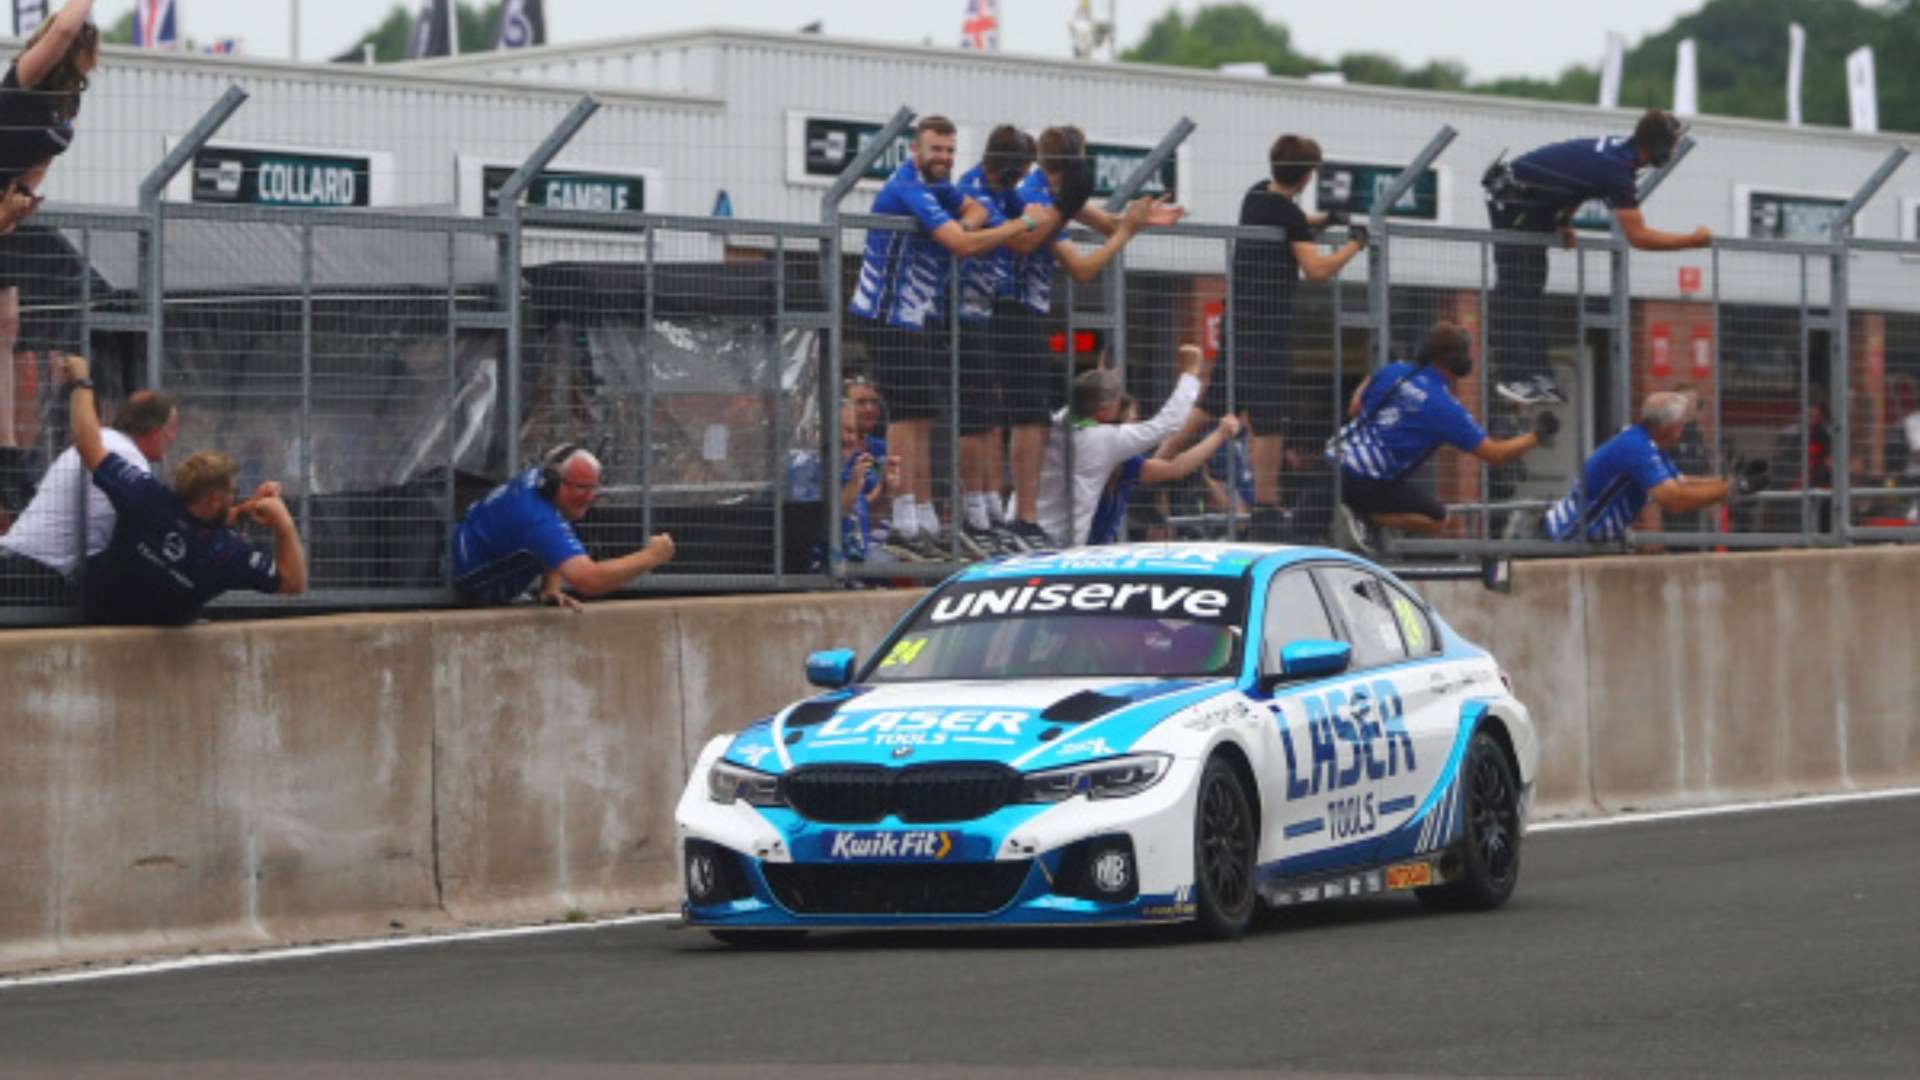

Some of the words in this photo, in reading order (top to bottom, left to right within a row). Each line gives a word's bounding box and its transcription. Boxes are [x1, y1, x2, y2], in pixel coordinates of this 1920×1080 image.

[258, 162, 355, 204] COLLARD
[546, 180, 628, 211] GAMBLE
[816, 710, 1029, 737] LASER
[874, 733, 947, 745] TOOLS
[1267, 679, 1416, 801] LASER
[1327, 792, 1377, 841] TOOLS
